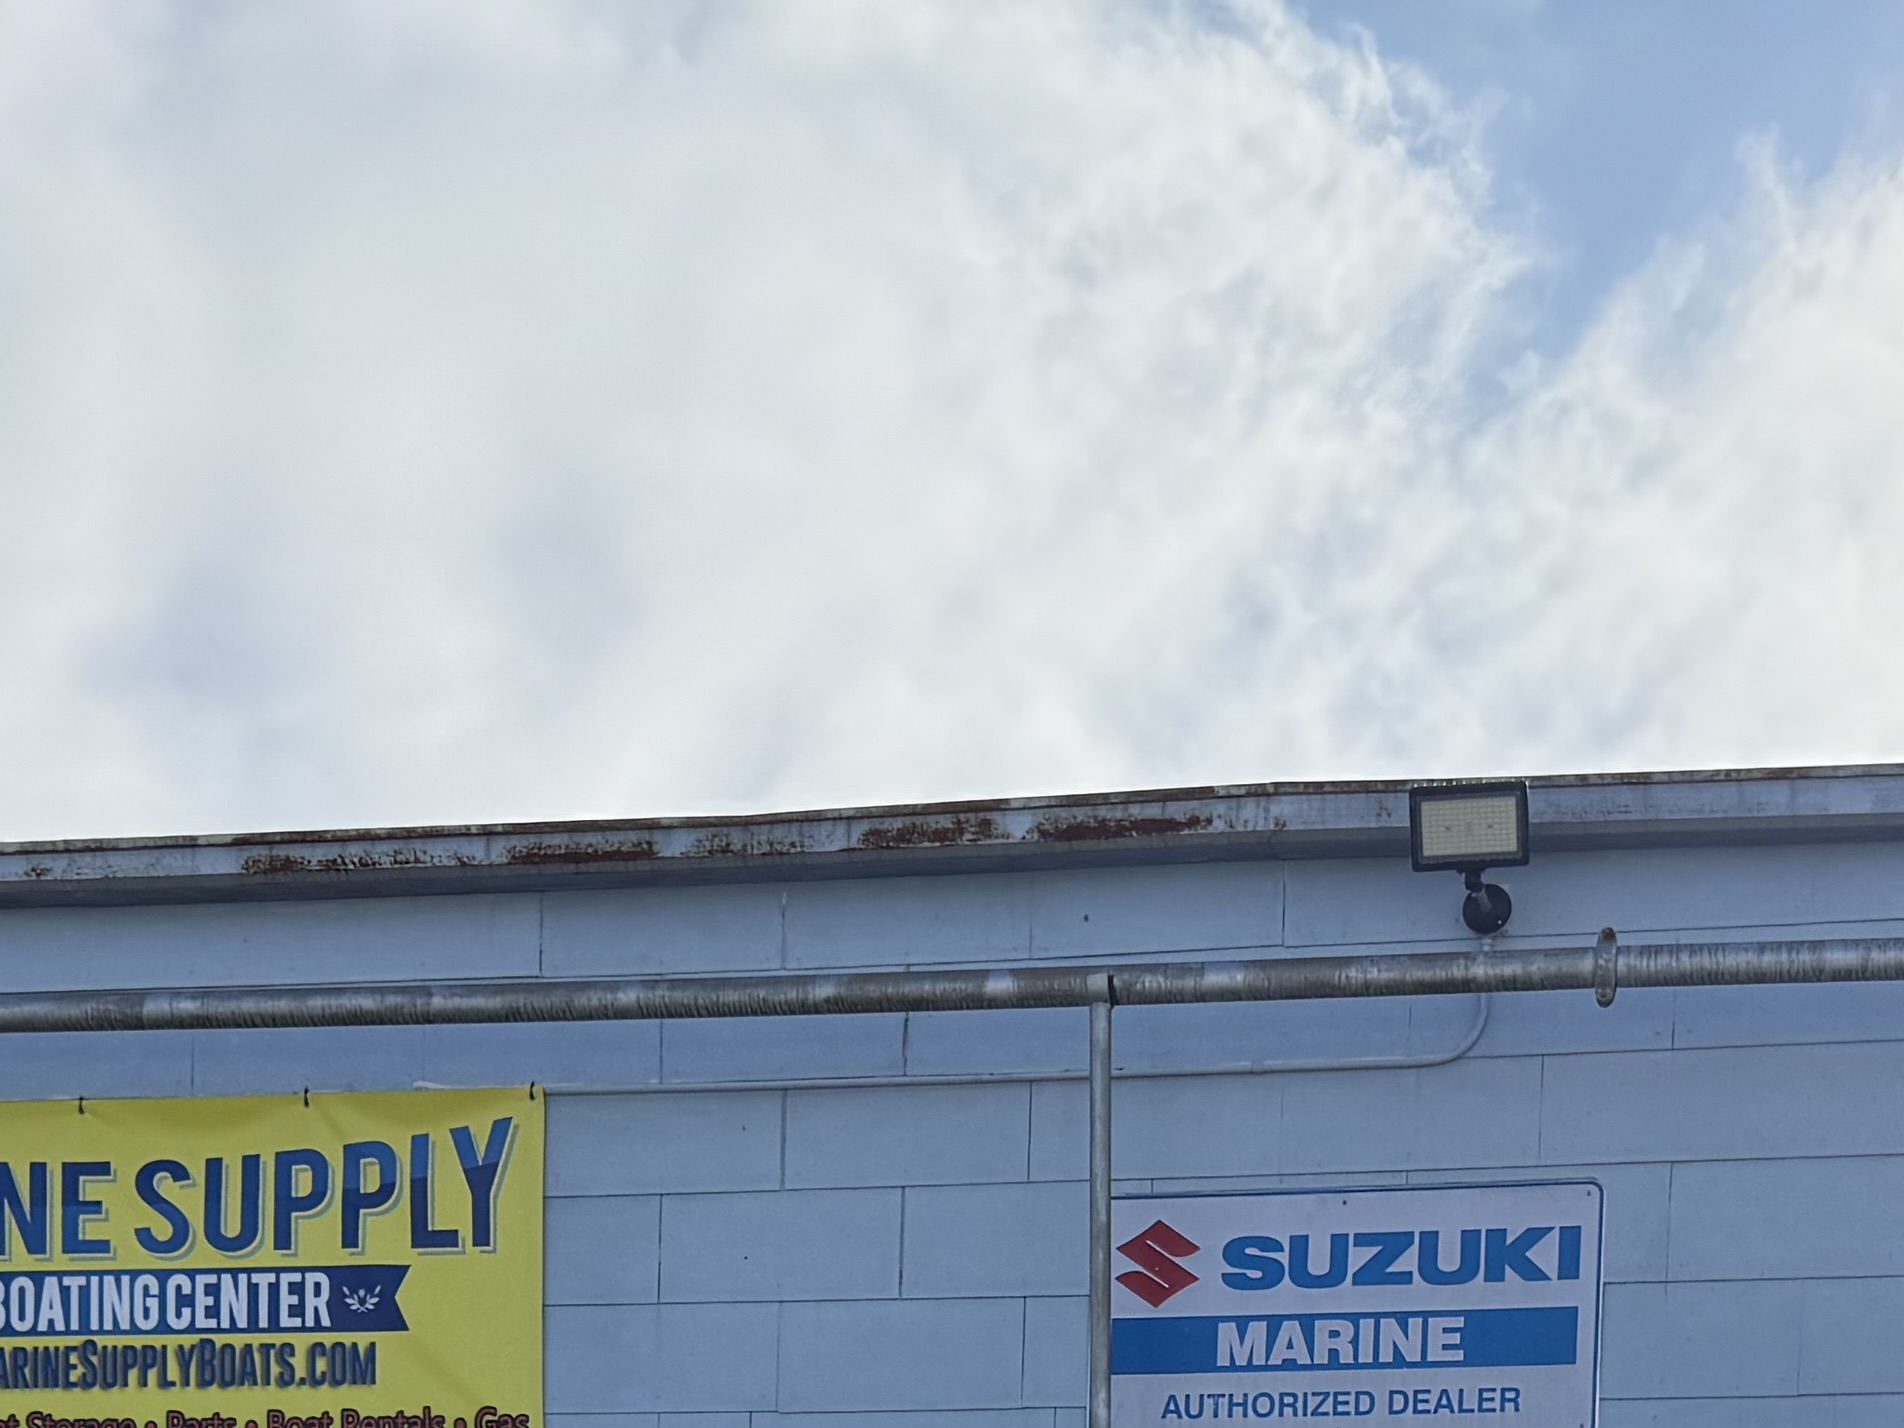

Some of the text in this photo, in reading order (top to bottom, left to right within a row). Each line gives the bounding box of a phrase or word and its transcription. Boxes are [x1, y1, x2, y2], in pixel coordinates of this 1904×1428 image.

[134, 1116, 518, 1260] SUPPLY
[1220, 1225, 1582, 1291] SUZUKI
[166, 1271, 332, 1331] CENTER
[1216, 1316, 1465, 1368] MARINE
[1161, 1387, 1521, 1420] AUTHORIZED DEALER
